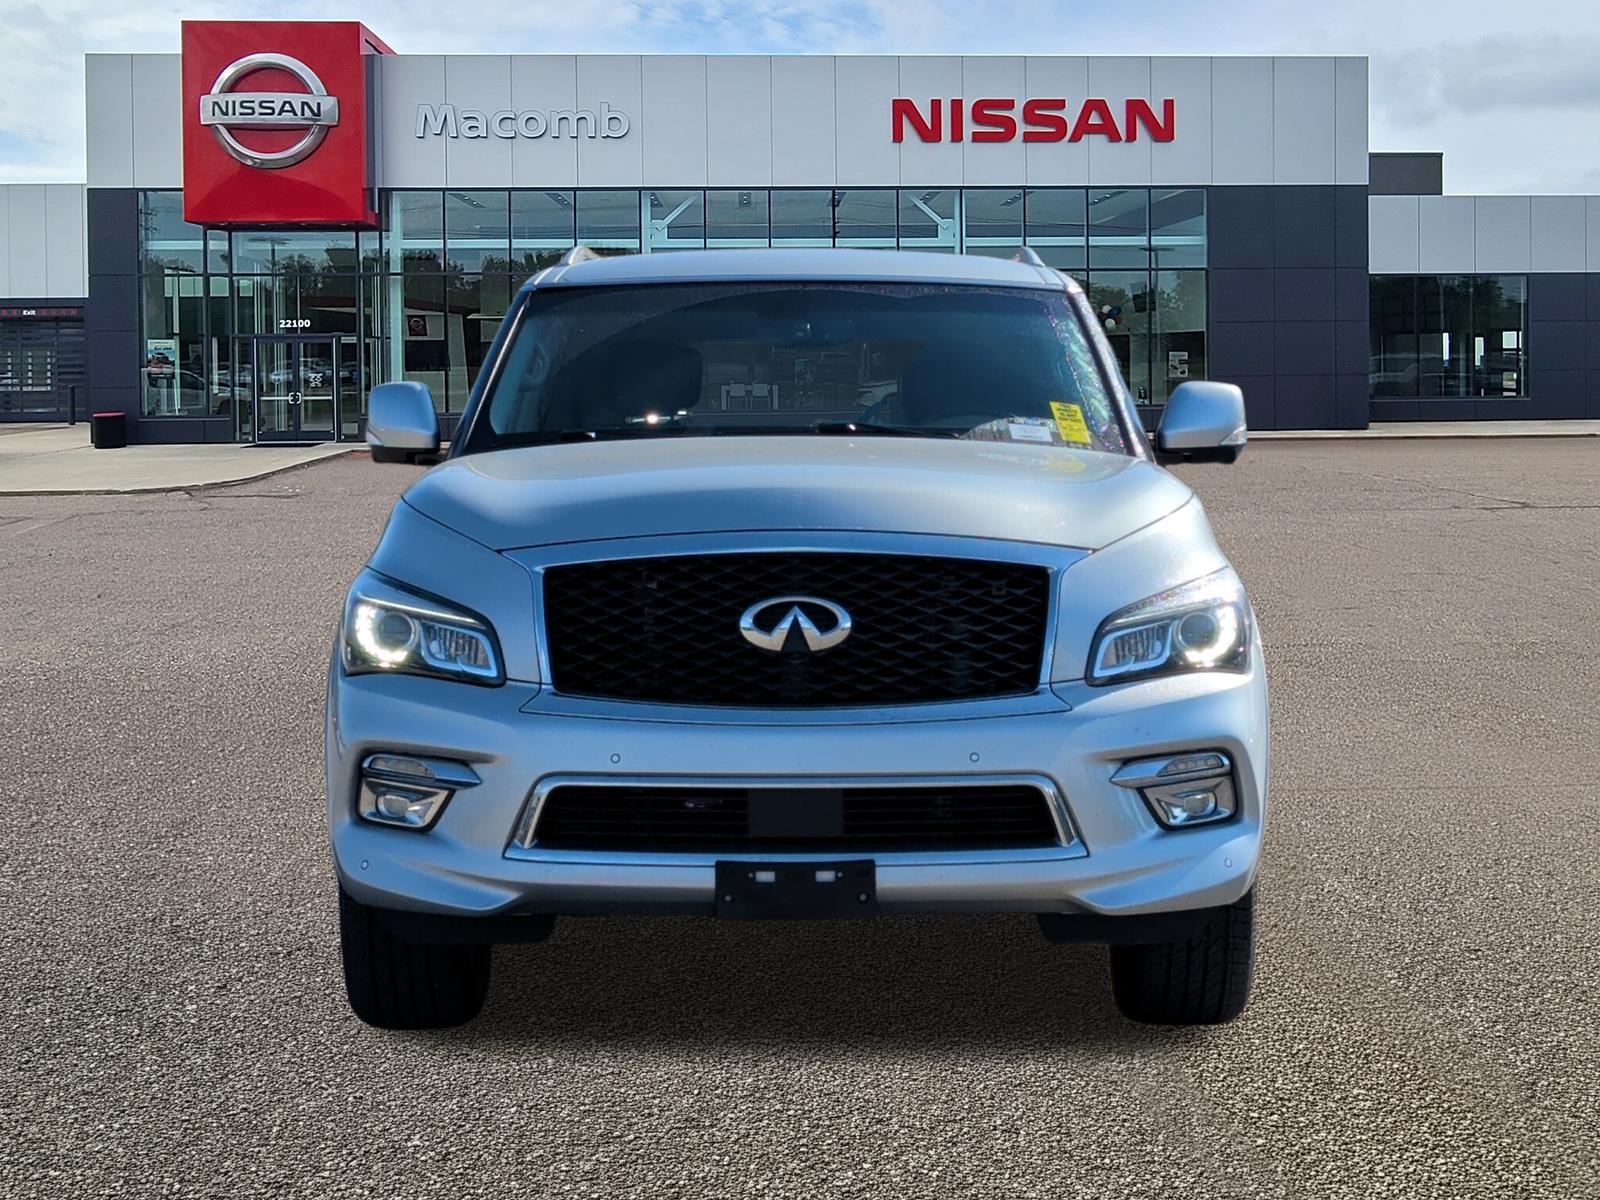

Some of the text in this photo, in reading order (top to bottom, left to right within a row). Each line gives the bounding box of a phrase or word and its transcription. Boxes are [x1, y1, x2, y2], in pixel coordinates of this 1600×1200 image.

[211, 100, 322, 117] NISSAN
[415, 102, 630, 139] Macomb
[892, 98, 1175, 143] NISSAN
[279, 319, 311, 328] 22100
